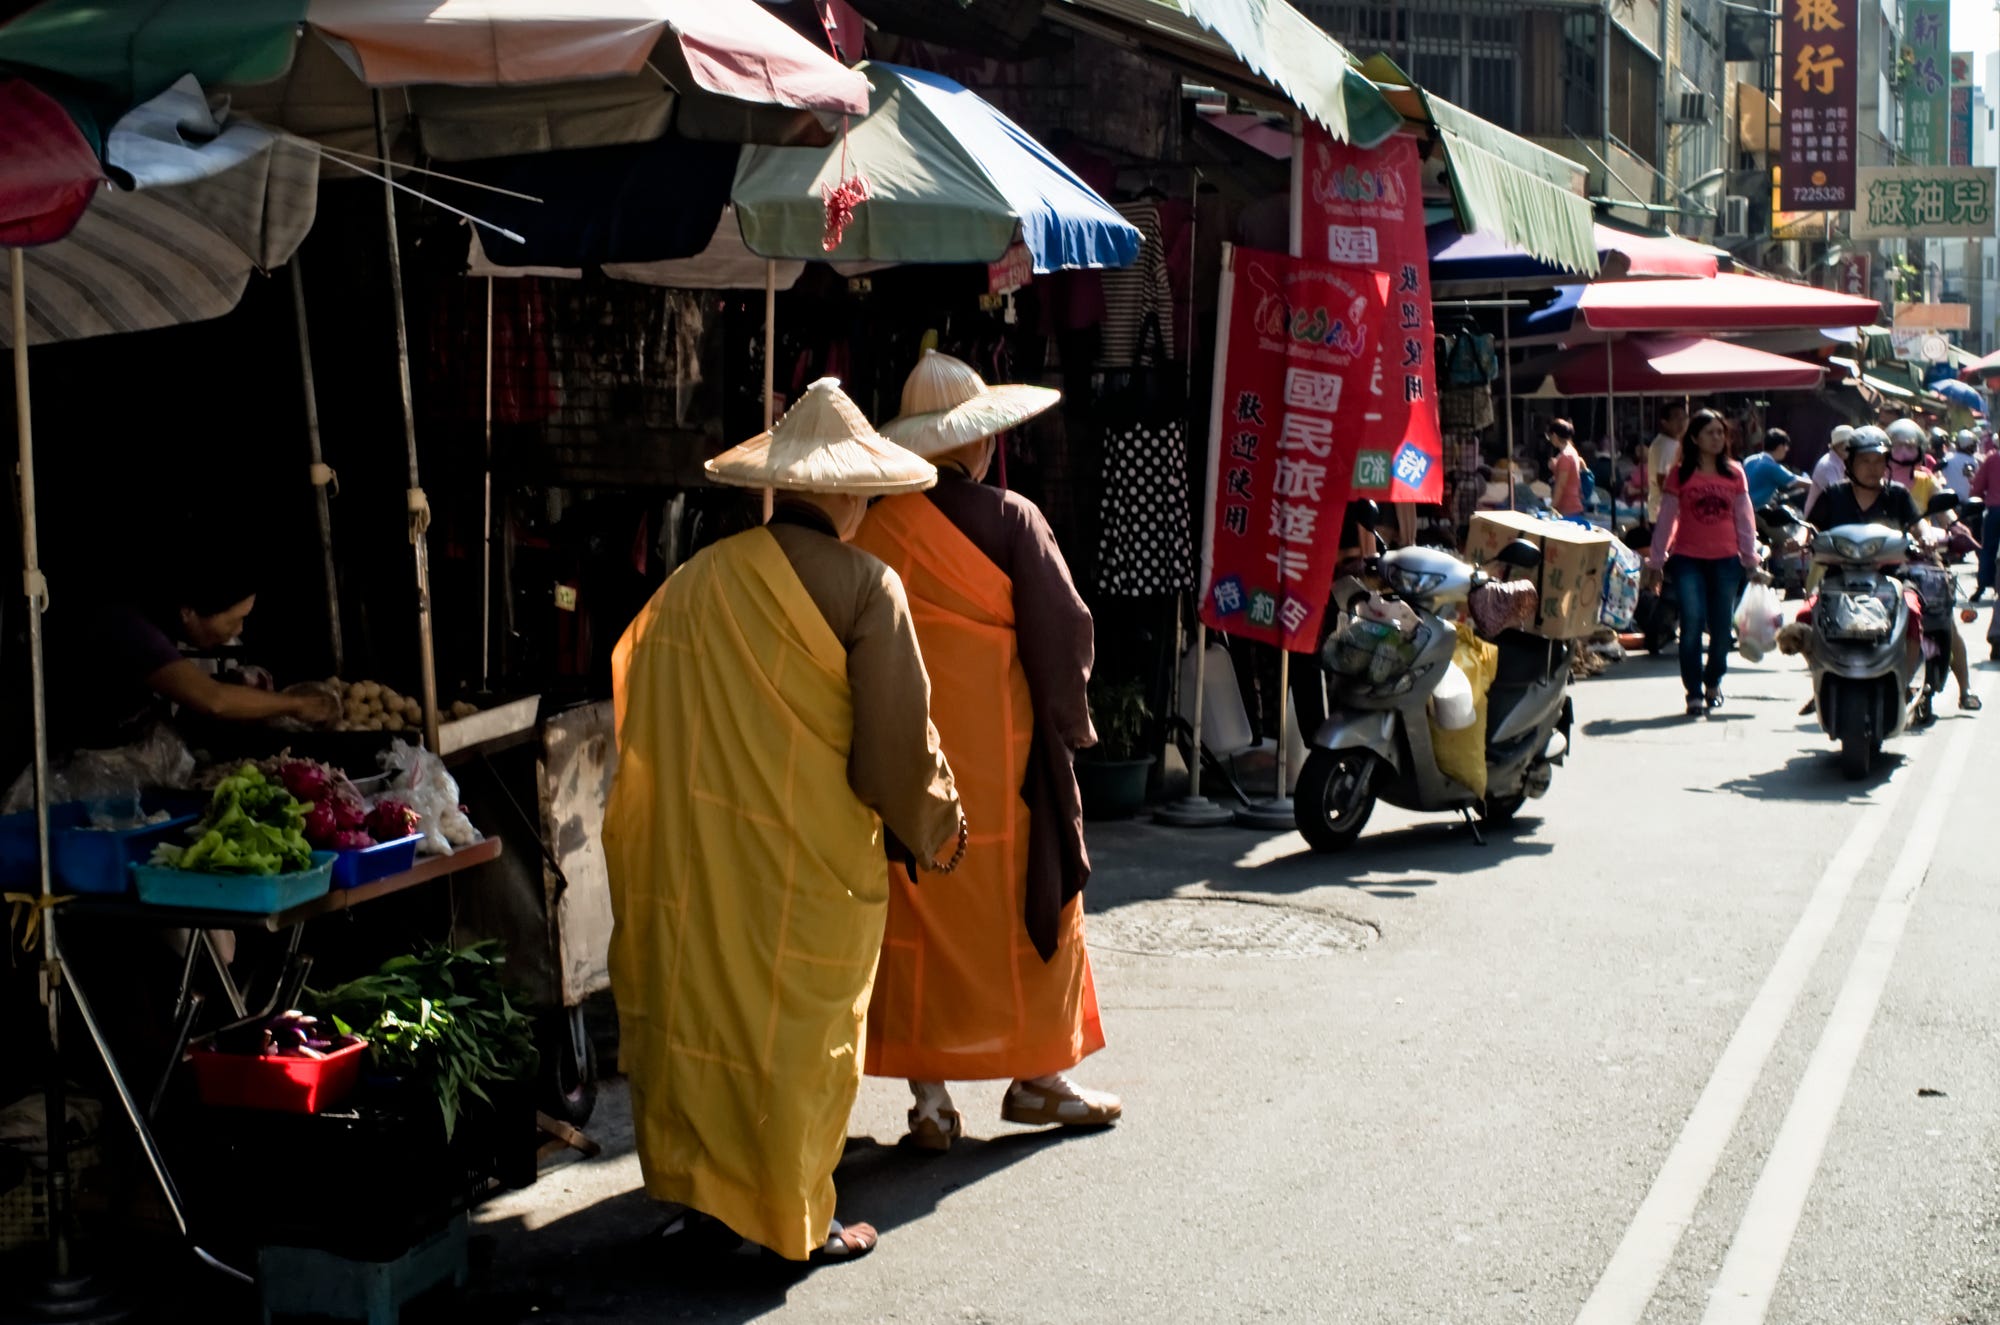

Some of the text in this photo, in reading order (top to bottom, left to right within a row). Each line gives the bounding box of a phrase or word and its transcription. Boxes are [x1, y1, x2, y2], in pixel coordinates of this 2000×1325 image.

[1792, 187, 1846, 202] 7225326
[1869, 180, 1986, 224] 綠袖兒
[1222, 391, 1266, 537] 歡迎使用
[1266, 366, 1343, 583] 國民旅遊卡
[1213, 581, 1308, 632] 特約店
